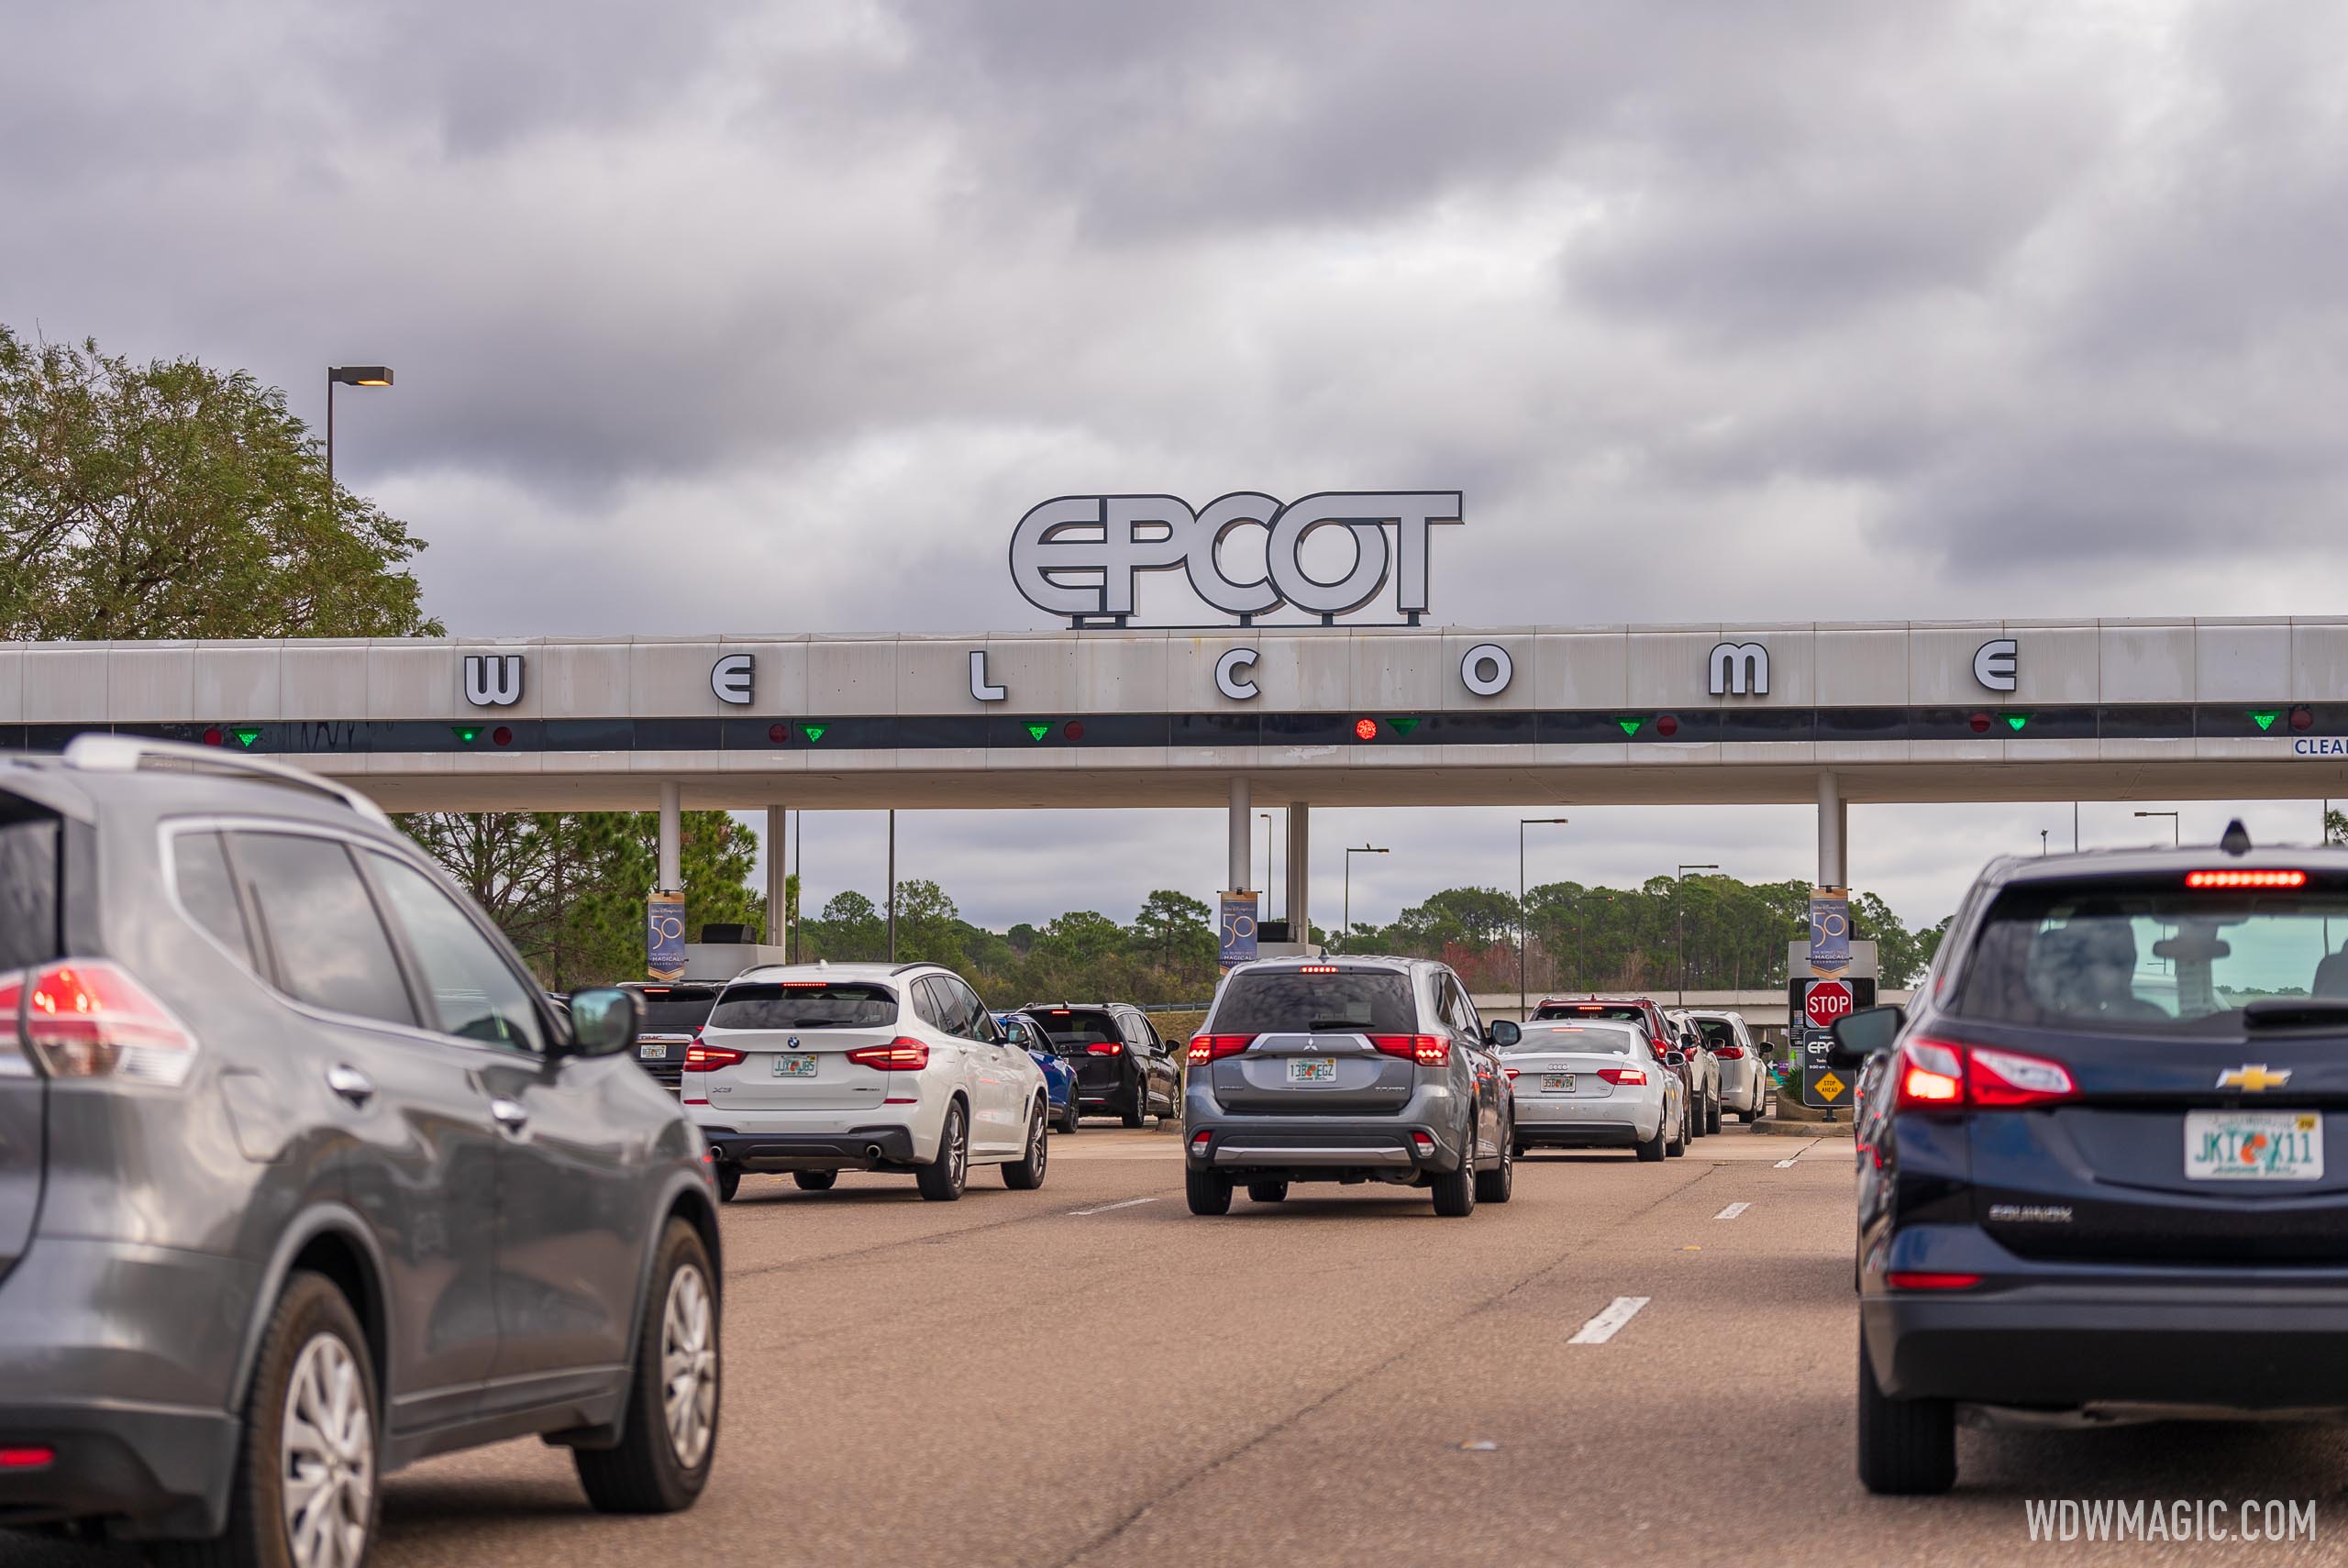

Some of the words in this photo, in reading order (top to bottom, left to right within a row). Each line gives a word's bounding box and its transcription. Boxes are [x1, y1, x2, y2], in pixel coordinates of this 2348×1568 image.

[1009, 491, 1465, 617] EPCOT
[2295, 739, 2348, 755] CLEA
[650, 915, 682, 950] 50
[1223, 913, 1255, 948] 50
[1813, 911, 1846, 948] 50
[1809, 996, 1849, 1013] STOP
[1807, 1041, 1835, 1055] EPC
